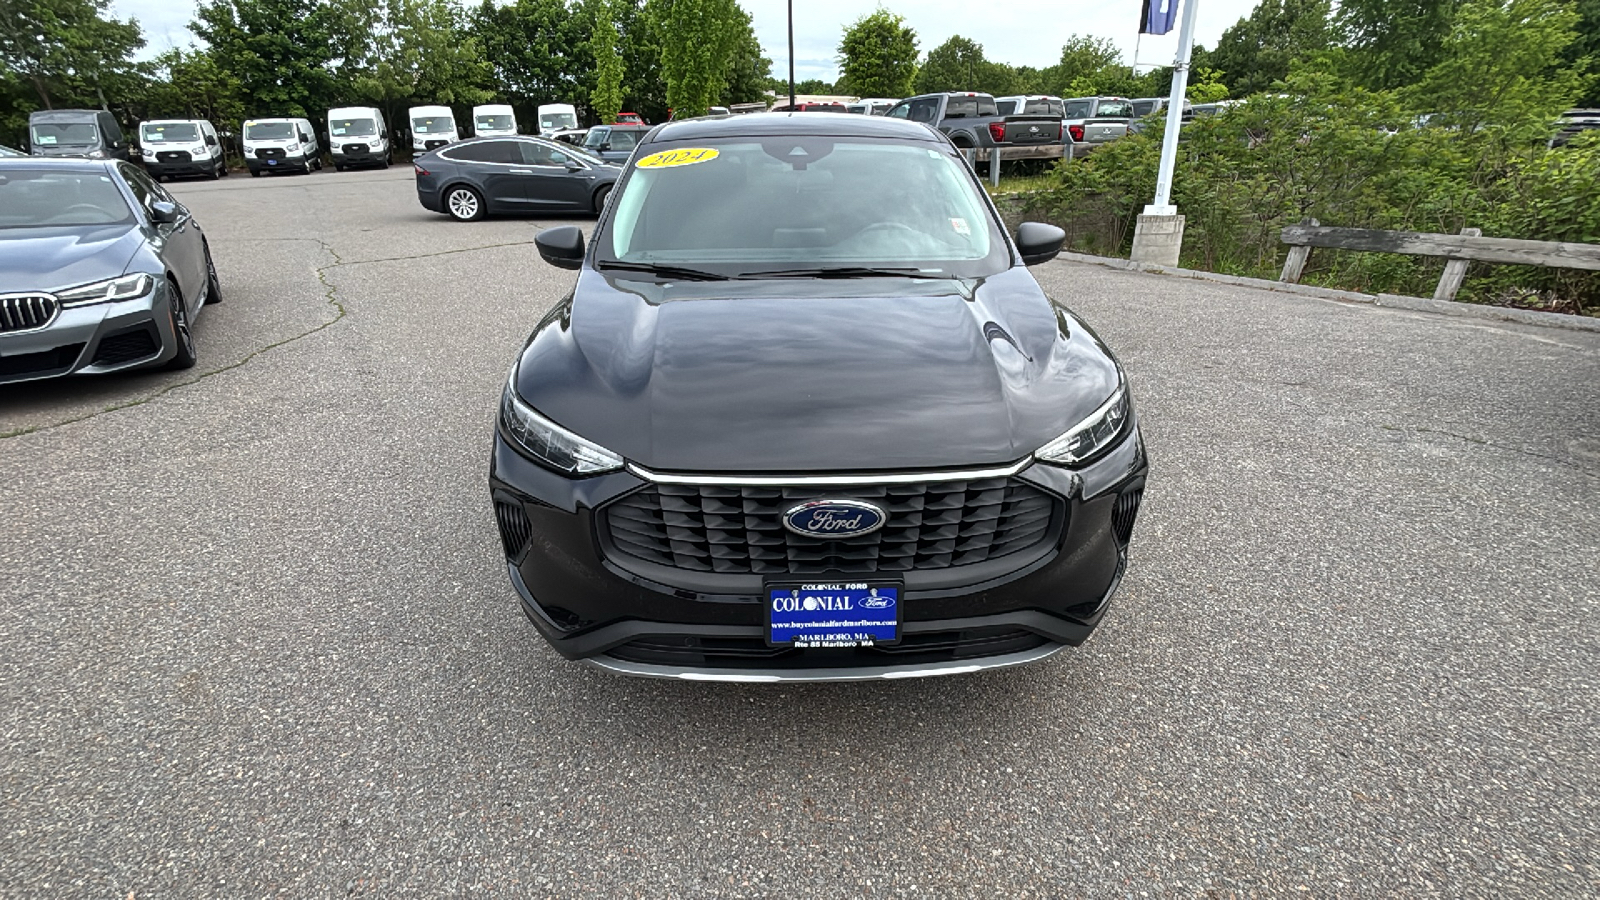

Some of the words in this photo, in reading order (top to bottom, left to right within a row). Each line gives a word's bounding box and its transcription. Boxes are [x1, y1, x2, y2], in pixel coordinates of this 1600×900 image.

[646, 150, 708, 167] 2024
[807, 509, 862, 531] Ford
[772, 596, 853, 612] COLONIAL
[865, 598, 888, 607] Ford
[771, 620, 898, 630] www.buycolonialfordmarlboro.com
[799, 633, 852, 641] MARLBORO,
